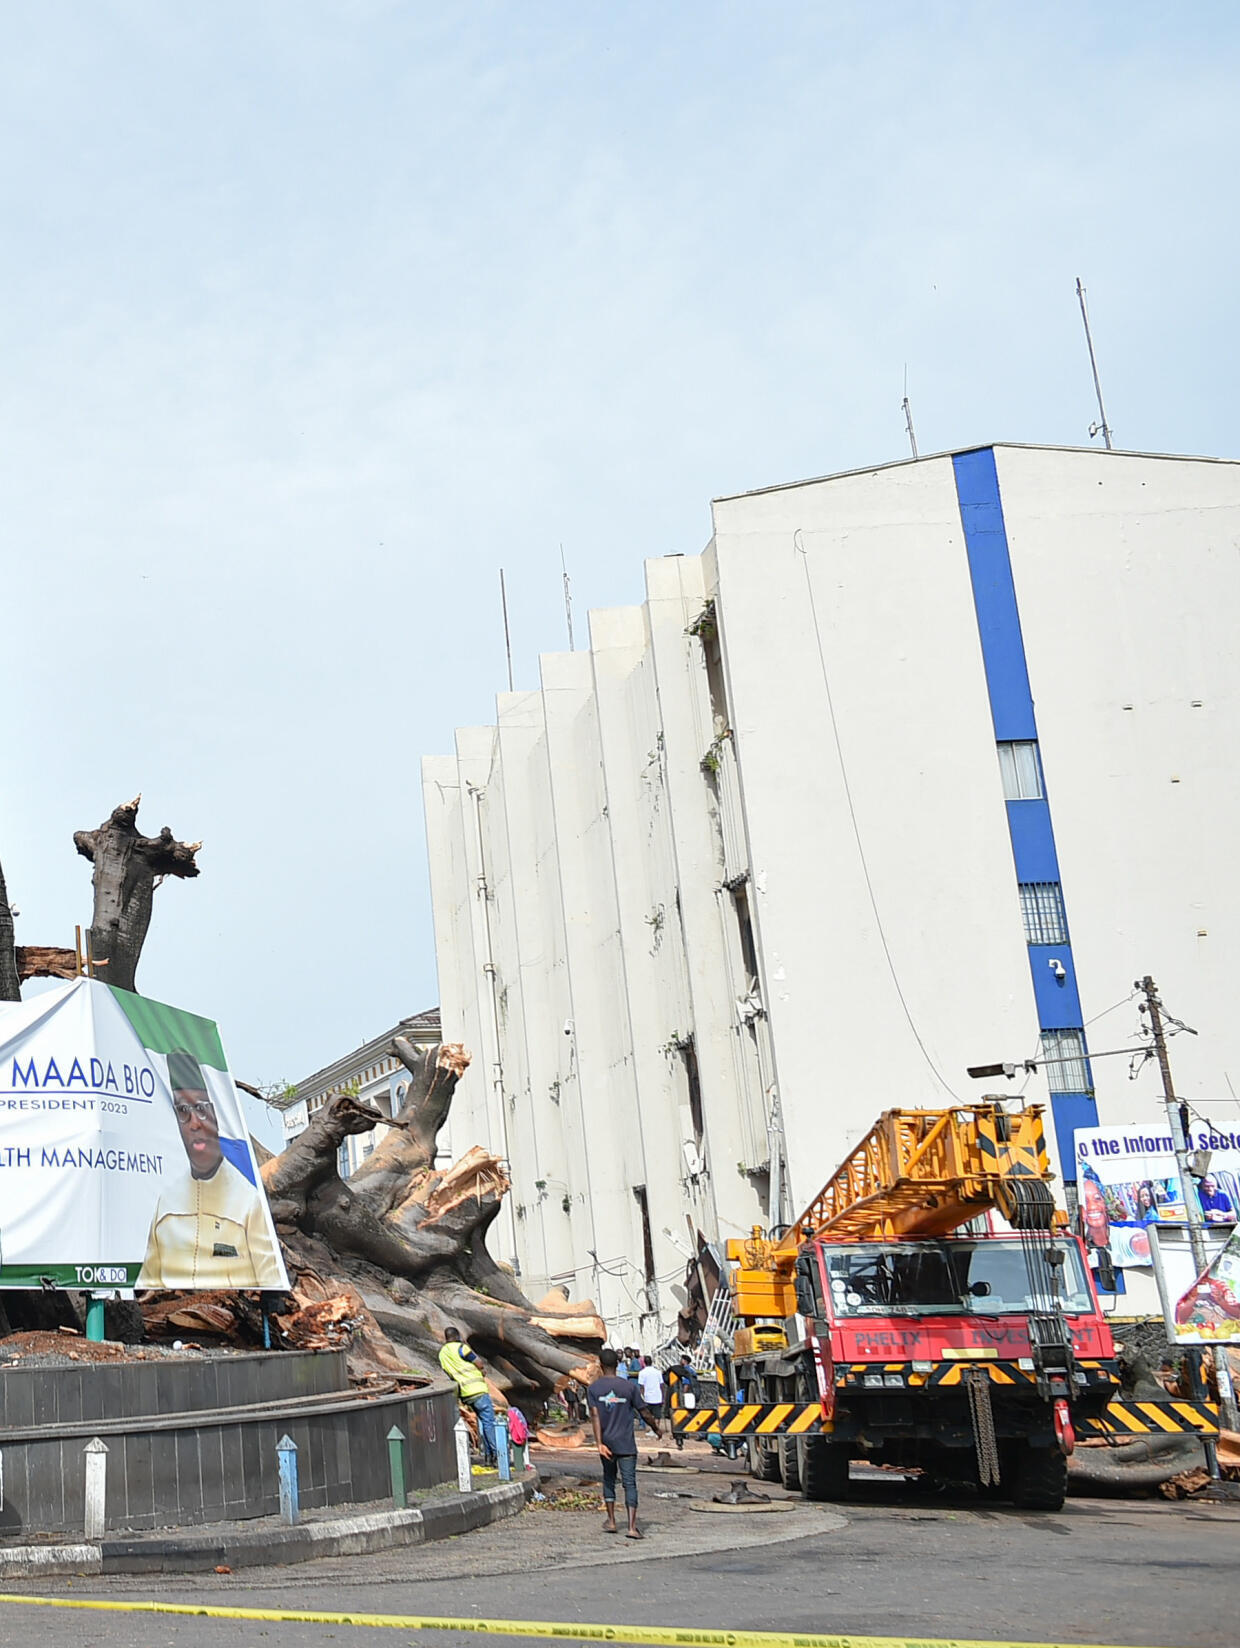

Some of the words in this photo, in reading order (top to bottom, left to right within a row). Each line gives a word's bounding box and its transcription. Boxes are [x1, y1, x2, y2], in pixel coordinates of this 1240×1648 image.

[12, 1056, 119, 1092] MAADA
[123, 1064, 155, 1098] BIO
[101, 1100, 128, 1115] 2023
[1092, 1138, 1119, 1156] the
[1123, 1133, 1194, 1153] Informl
[40, 1146, 163, 1175] MANAGEMENT
[110, 1268, 127, 1283] DO
[856, 1331, 922, 1346] PHELIX
